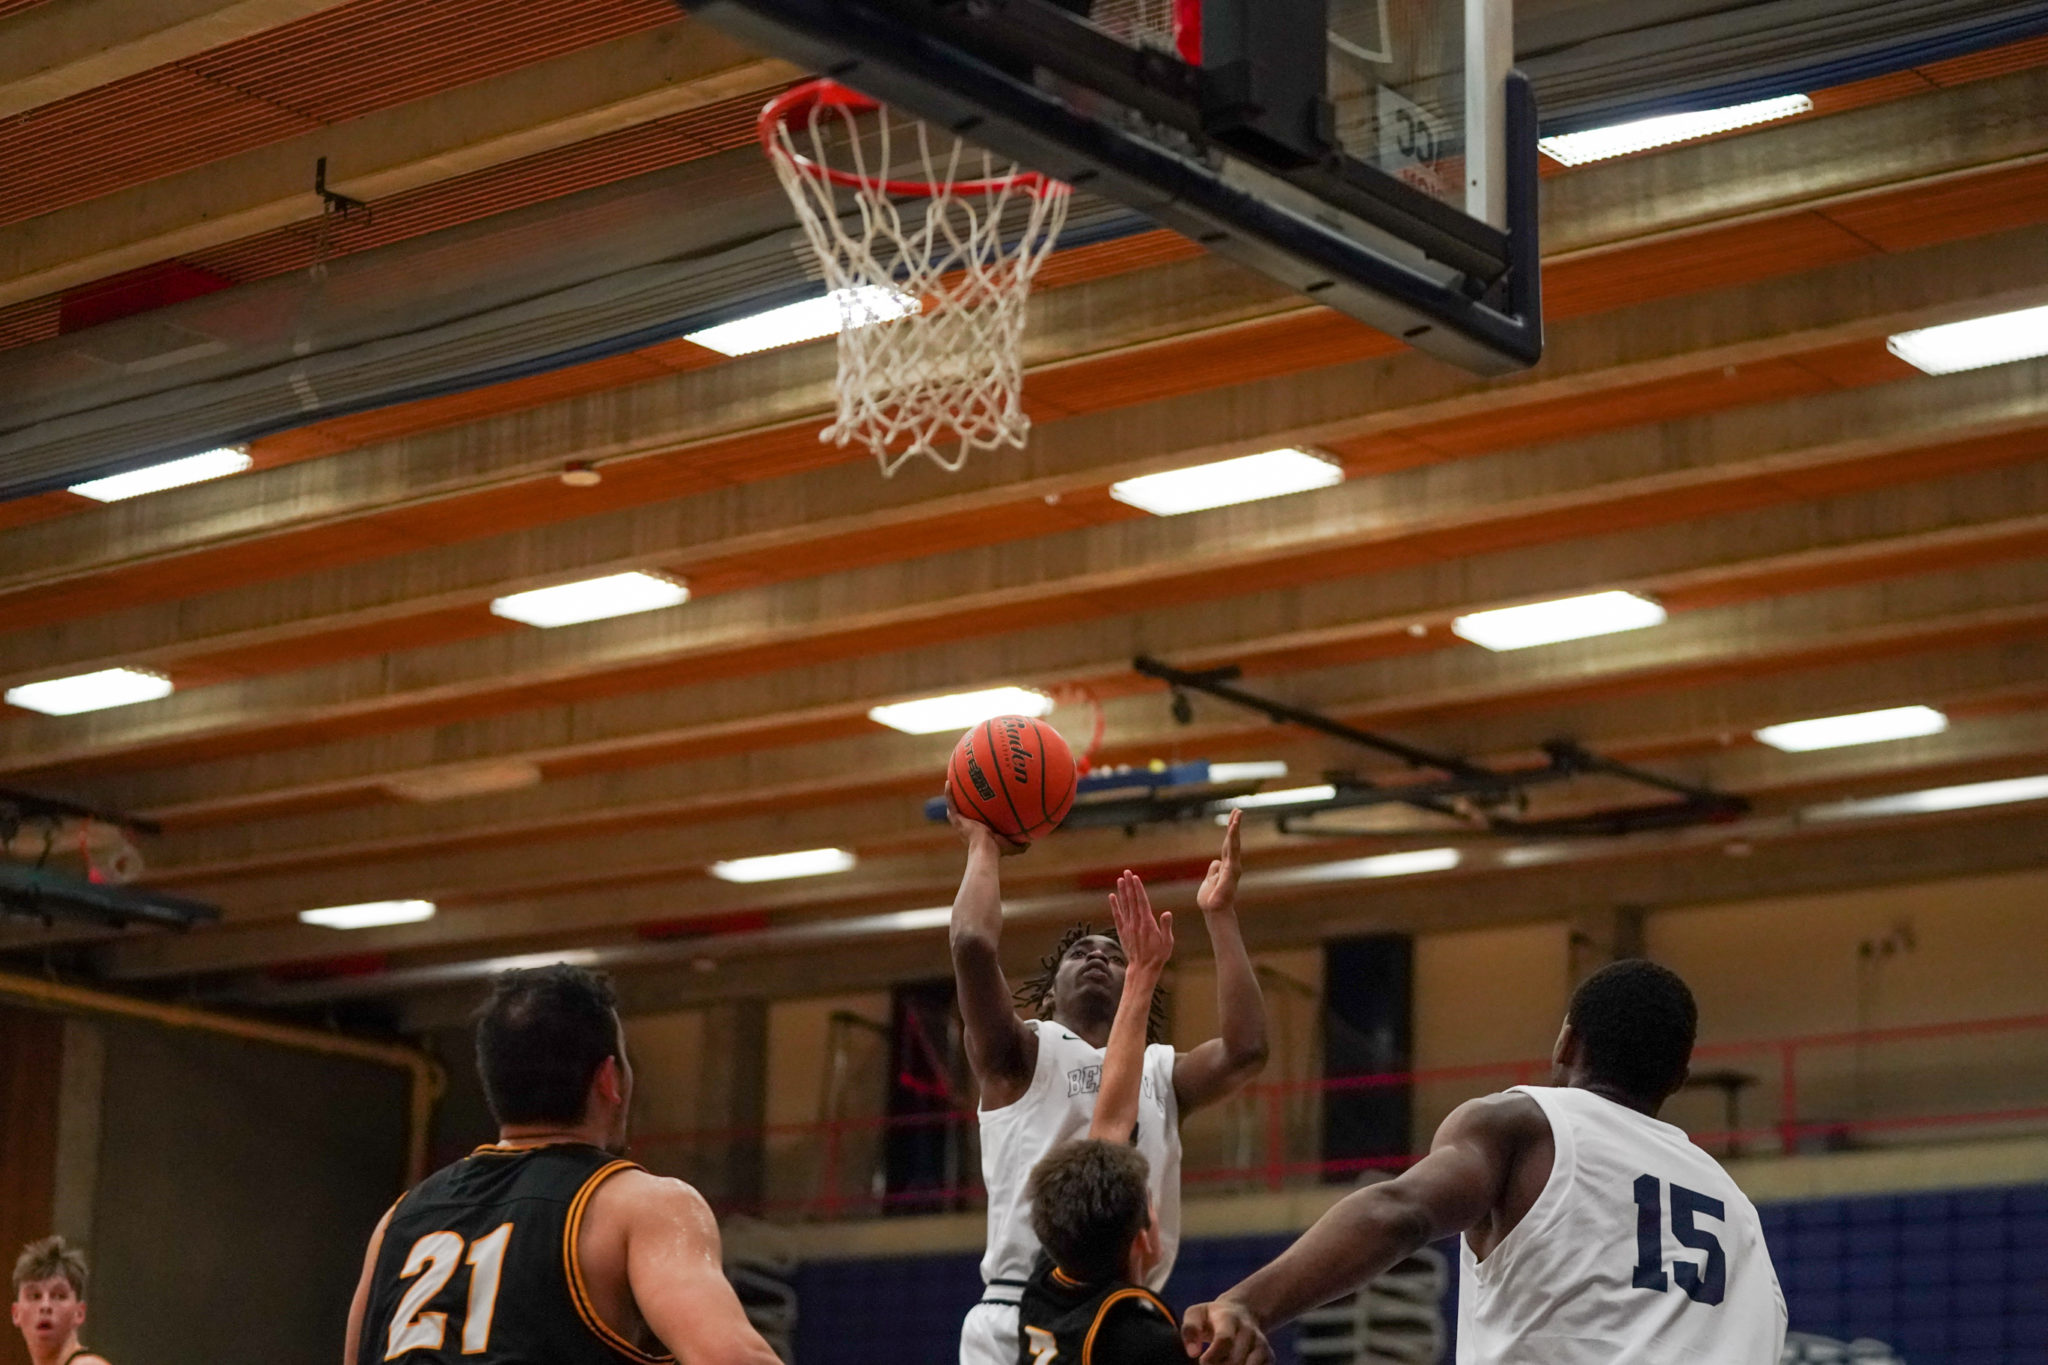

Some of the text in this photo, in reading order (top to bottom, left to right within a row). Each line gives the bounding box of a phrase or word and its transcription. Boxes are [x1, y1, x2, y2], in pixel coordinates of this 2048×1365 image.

[1002, 717, 1033, 784] Baden
[384, 1222, 514, 1362] 21
[1632, 1173, 1726, 1307] 15
